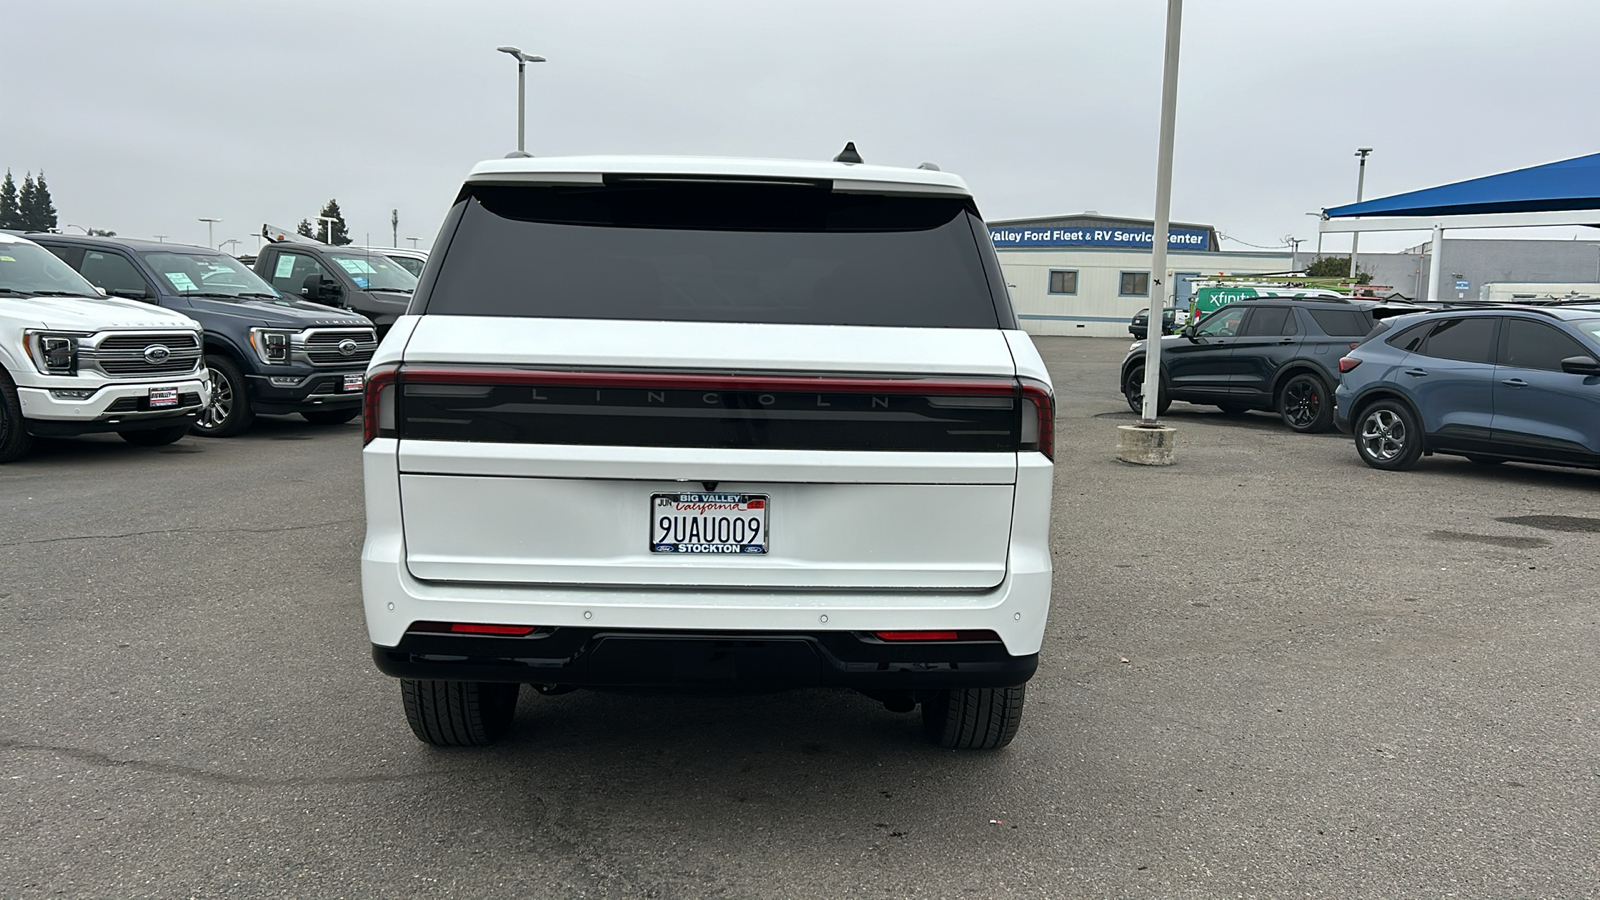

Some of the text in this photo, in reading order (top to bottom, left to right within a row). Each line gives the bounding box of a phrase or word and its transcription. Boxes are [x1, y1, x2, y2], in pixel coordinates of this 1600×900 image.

[1024, 231, 1050, 241] Ford
[1053, 230, 1083, 241] Fleet
[1094, 231, 1112, 241] RV
[1114, 231, 1155, 242] Servic
[1210, 292, 1256, 306] xfinit
[532, 387, 889, 408] LINCOLN
[658, 499, 673, 507] JUN
[680, 494, 740, 503] BIG VALLEY
[675, 502, 747, 515] California
[658, 516, 761, 543] 9UAU009
[678, 544, 741, 553] STOCKTON
